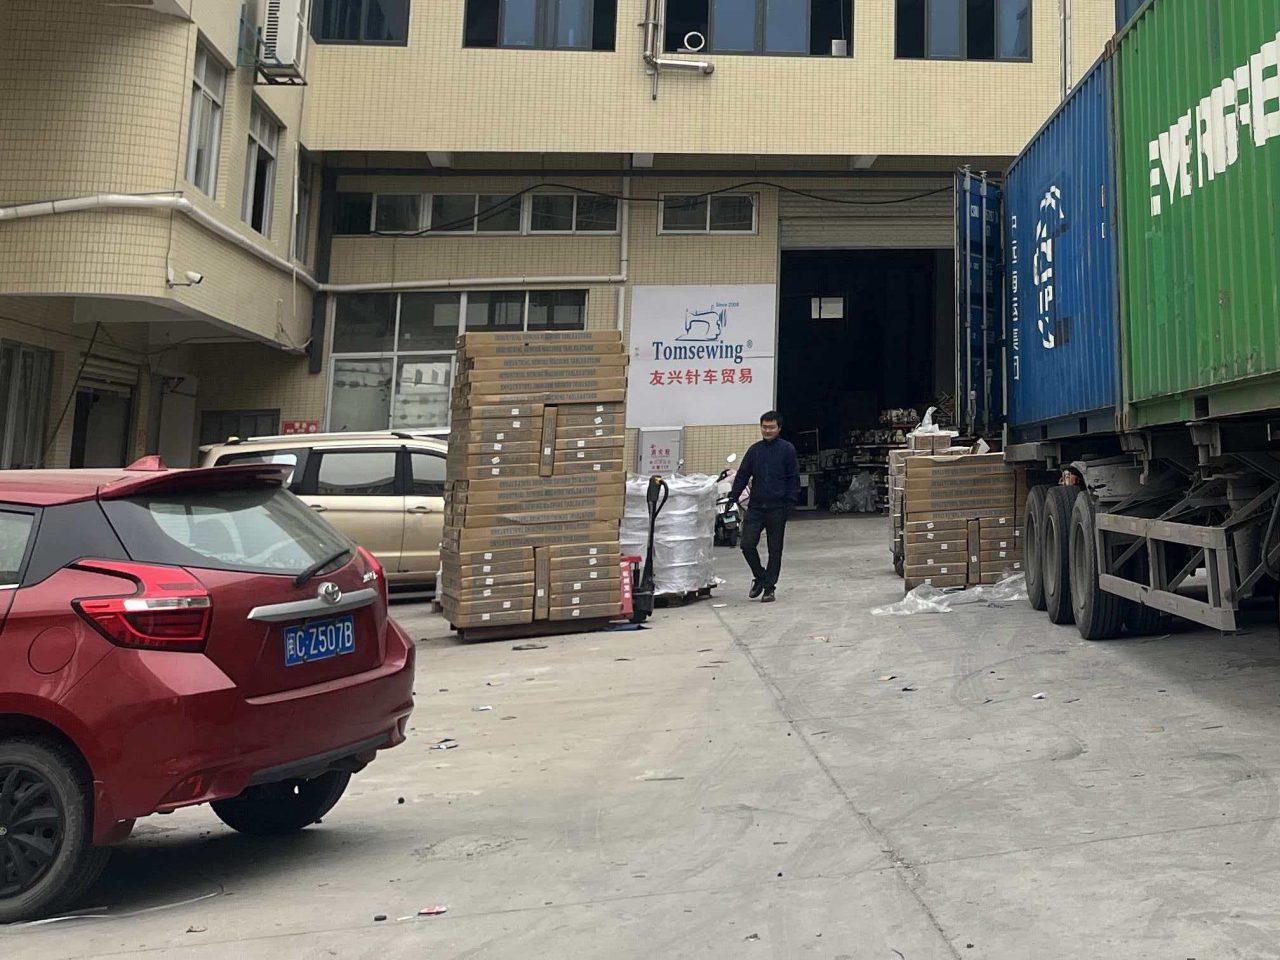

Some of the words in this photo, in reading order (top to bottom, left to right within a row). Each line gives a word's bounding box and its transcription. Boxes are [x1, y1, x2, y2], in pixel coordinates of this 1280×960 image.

[652, 339, 744, 365] Tomsewing
[649, 367, 753, 386] 友兴针车贸易
